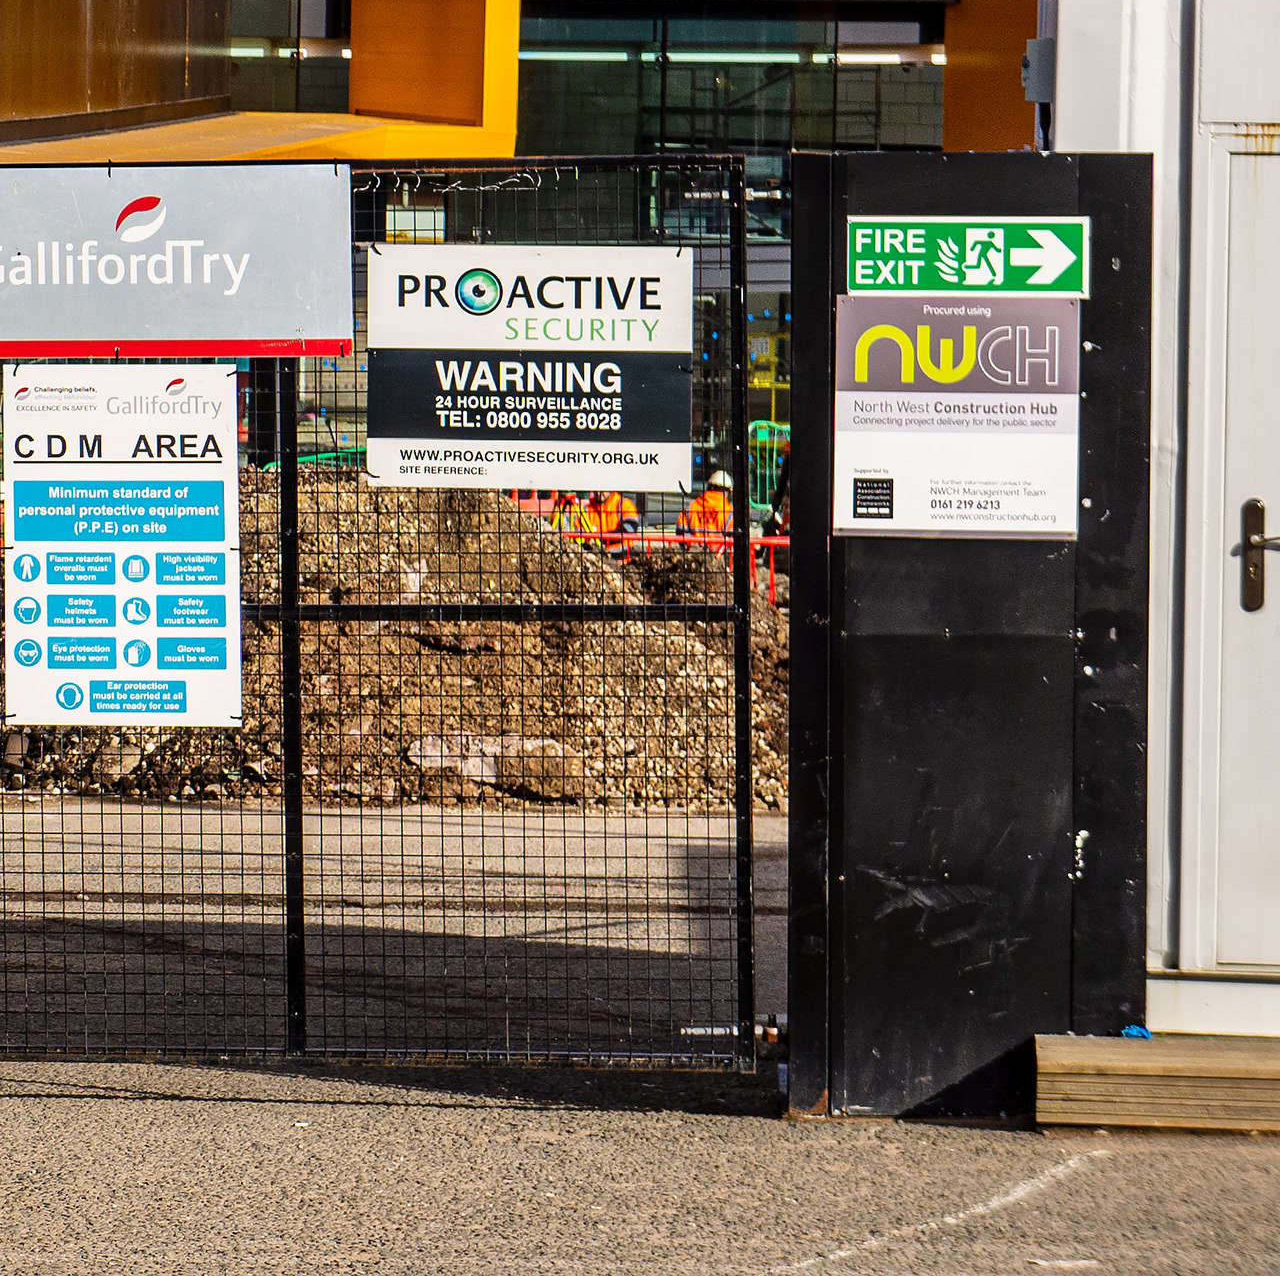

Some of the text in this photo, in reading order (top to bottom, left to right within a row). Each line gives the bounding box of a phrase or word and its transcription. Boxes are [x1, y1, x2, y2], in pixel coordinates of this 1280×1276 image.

[856, 229, 926, 253] FIRE
[856, 260, 925, 284] EXIT
[923, 305, 991, 317] Procured using
[505, 317, 660, 342] SECURITY
[435, 360, 622, 393] WARNING
[435, 396, 622, 411] 24 HOUR SURVEILLANCE
[854, 400, 1057, 414] North West Construction Hub
[436, 411, 621, 430] TEL: 0800 955 8028
[131, 435, 222, 458] AREA
[399, 449, 659, 465] WWW.PROACTIVESECURITY.ORG.UK
[399, 466, 487, 475] SITE REFERENCE:
[49, 487, 188, 498] Minimum standard of
[18, 505, 220, 519] personal protective equipment
[931, 500, 1000, 510] 0161 219 6213
[74, 522, 167, 535] (P.P.E) on site
